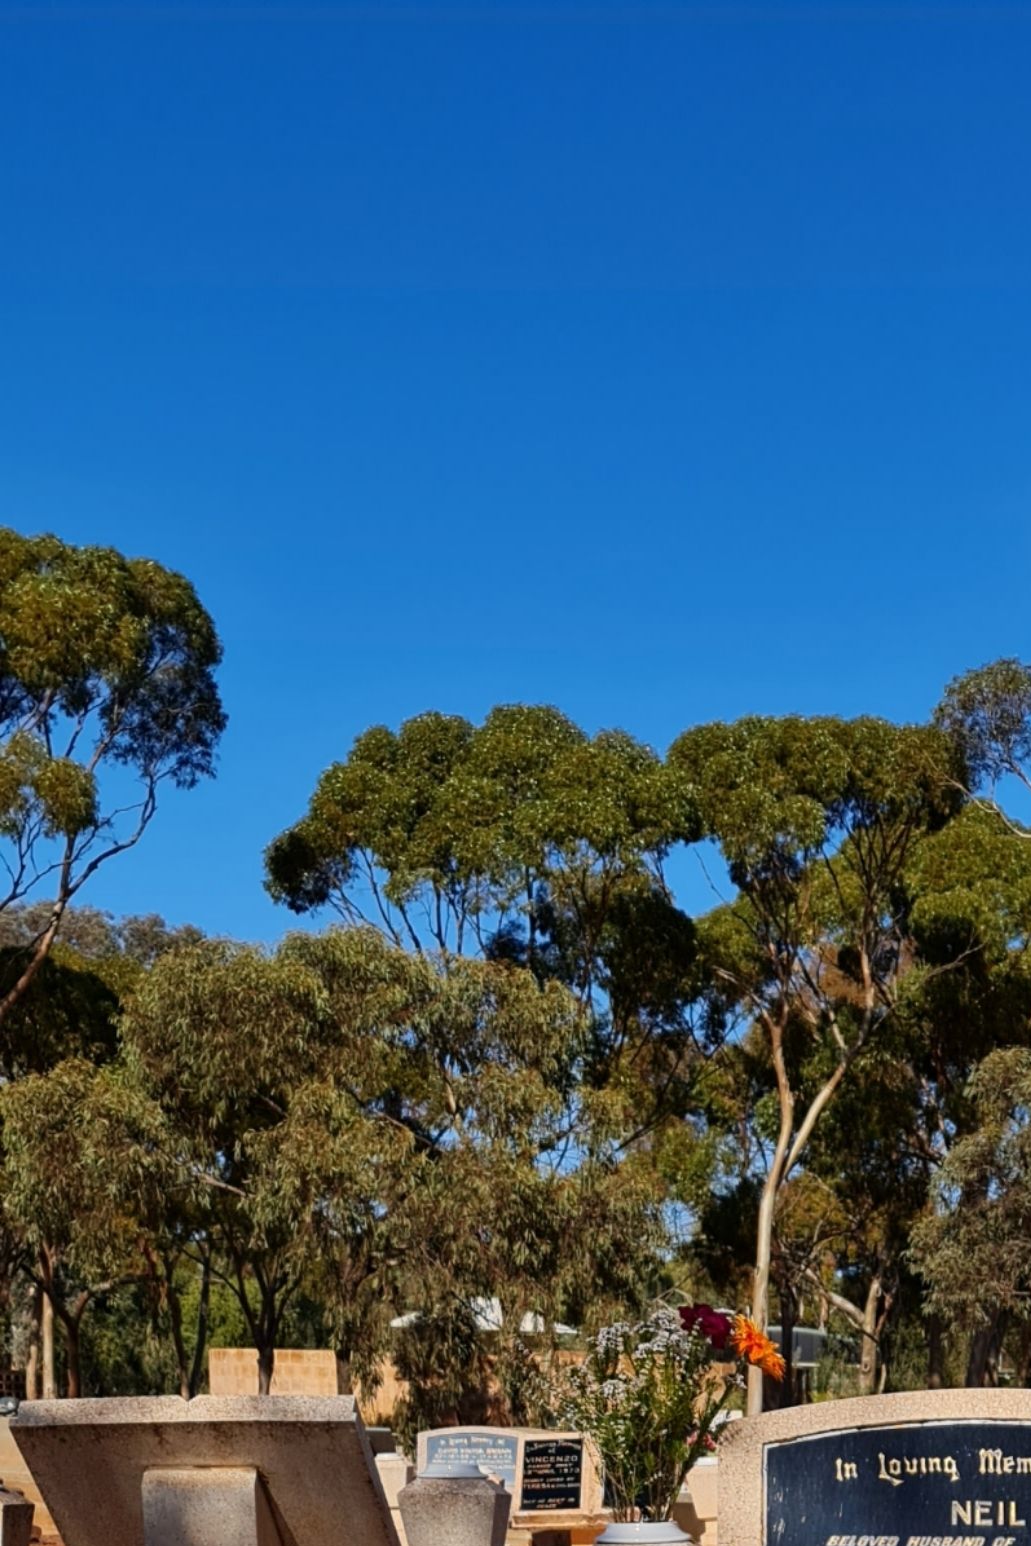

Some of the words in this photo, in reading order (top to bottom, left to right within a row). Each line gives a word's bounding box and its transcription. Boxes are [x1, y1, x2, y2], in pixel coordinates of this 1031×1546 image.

[835, 1457, 858, 1481] In
[878, 1452, 960, 1486] Loving
[951, 1500, 1026, 1526] NEIL
